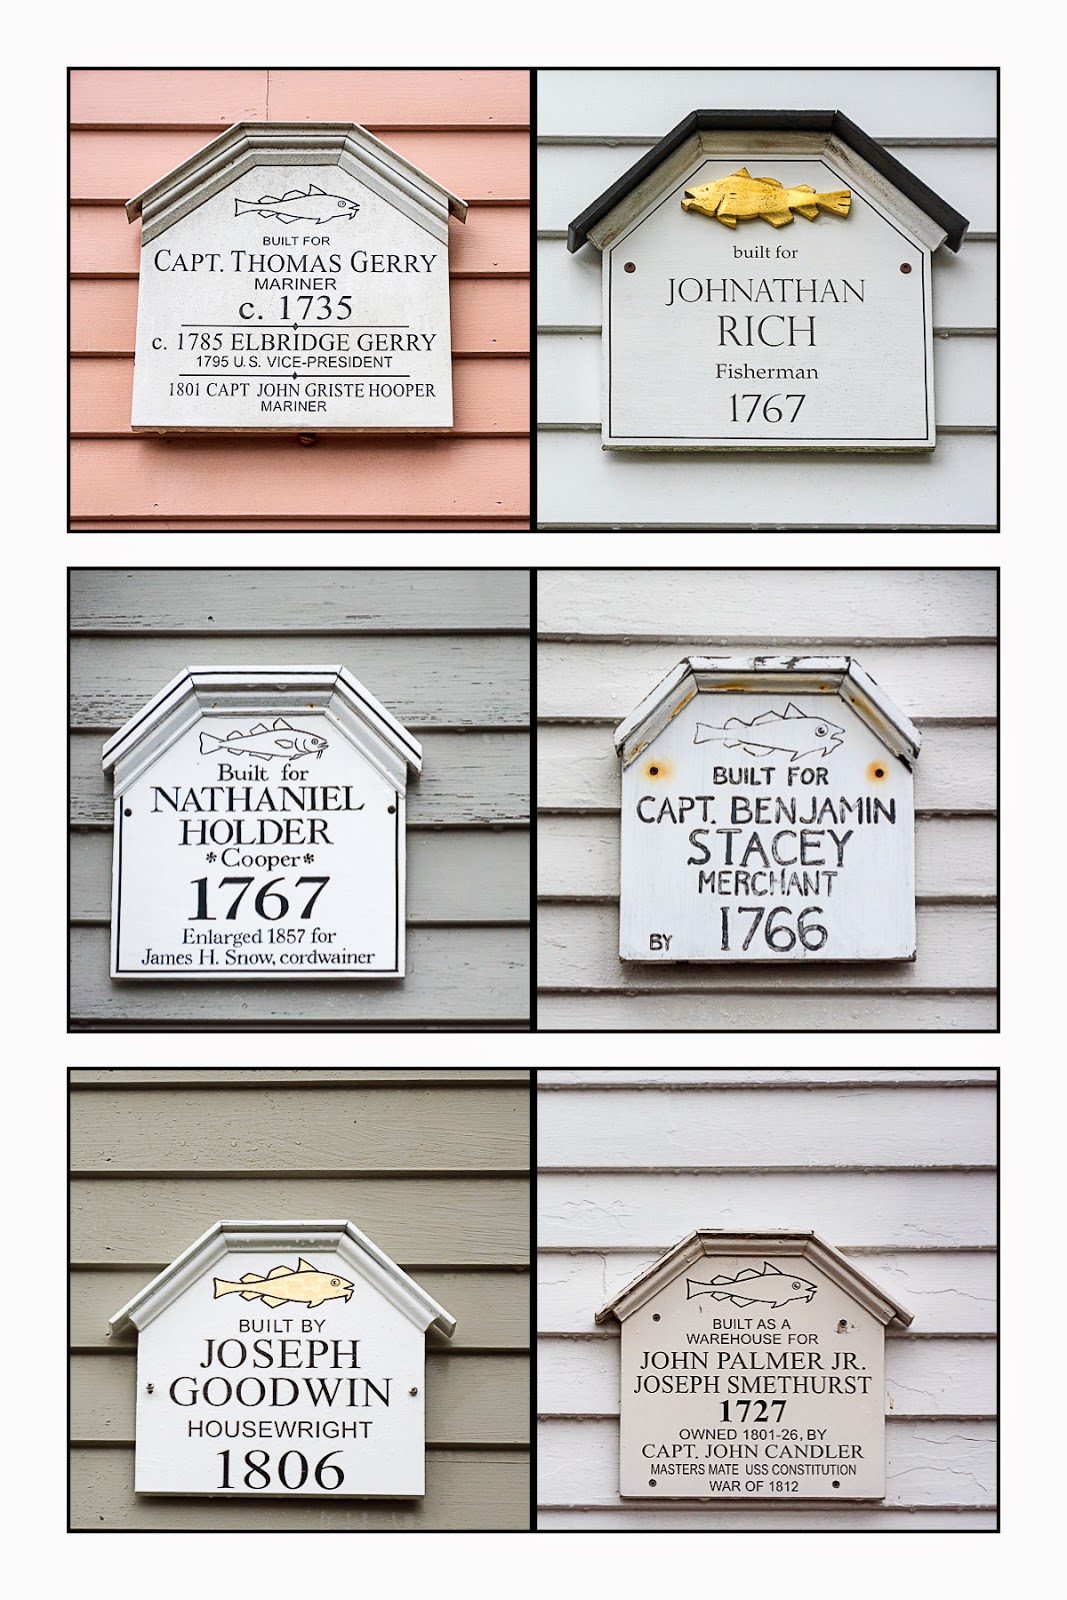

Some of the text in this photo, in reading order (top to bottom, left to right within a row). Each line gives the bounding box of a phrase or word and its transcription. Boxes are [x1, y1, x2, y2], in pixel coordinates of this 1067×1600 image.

[263, 236, 330, 246] BUILT FOR
[154, 249, 438, 274] CAPT. THOMAS GERRY
[733, 246, 798, 260] built for
[255, 278, 337, 290] MARINER
[665, 278, 865, 306] JOHNATHAN
[239, 296, 353, 320] c. 1735
[718, 314, 817, 347] RICH
[152, 333, 438, 351] c. 1785 ELBRIDGE GERRY
[197, 356, 229, 368] 1795
[268, 356, 392, 368] VICE-PRESIDENT
[715, 363, 819, 380] Fisherman
[169, 382, 436, 398] 1801 CAPT JOHN GRISTE HOOPER
[261, 401, 327, 411] MARINER
[729, 393, 806, 423] 1767
[217, 764, 308, 782] Built for
[713, 766, 829, 786] BUILT FOR
[150, 786, 365, 813] NATHANIEL
[636, 796, 896, 824] CAPT. BENJAMIN
[178, 819, 334, 846] HOLDER
[688, 829, 854, 868] STACEY
[698, 870, 838, 897] MERCHANT
[188, 876, 330, 921] 1767
[182, 927, 336, 948] Enlarged 1857 for
[720, 906, 828, 952] 1766
[650, 933, 672, 951] BY
[141, 949, 375, 966] James H. Snow, cordwainer
[239, 1319, 326, 1333] BUILT BY
[713, 1318, 791, 1330] BUILT AS A
[686, 1333, 819, 1345] WAREHOUSE FOR
[200, 1338, 361, 1370] JOSEPH
[640, 1351, 866, 1370] JOHN PALMER JR.
[169, 1376, 393, 1408] GOODWIN
[634, 1376, 872, 1394] JOSEPH SMETHURST
[719, 1399, 787, 1423] 1727
[188, 1420, 373, 1439] HOUSEWRIGHT
[679, 1428, 827, 1442] OWNED 1801-26, BY
[642, 1443, 864, 1459] CAPT. JOHN CANDLER
[217, 1450, 345, 1490] 1806
[651, 1463, 856, 1476] MASTERS MATE USS CONSTITUTION
[710, 1480, 799, 1492] WAR OF 1812
